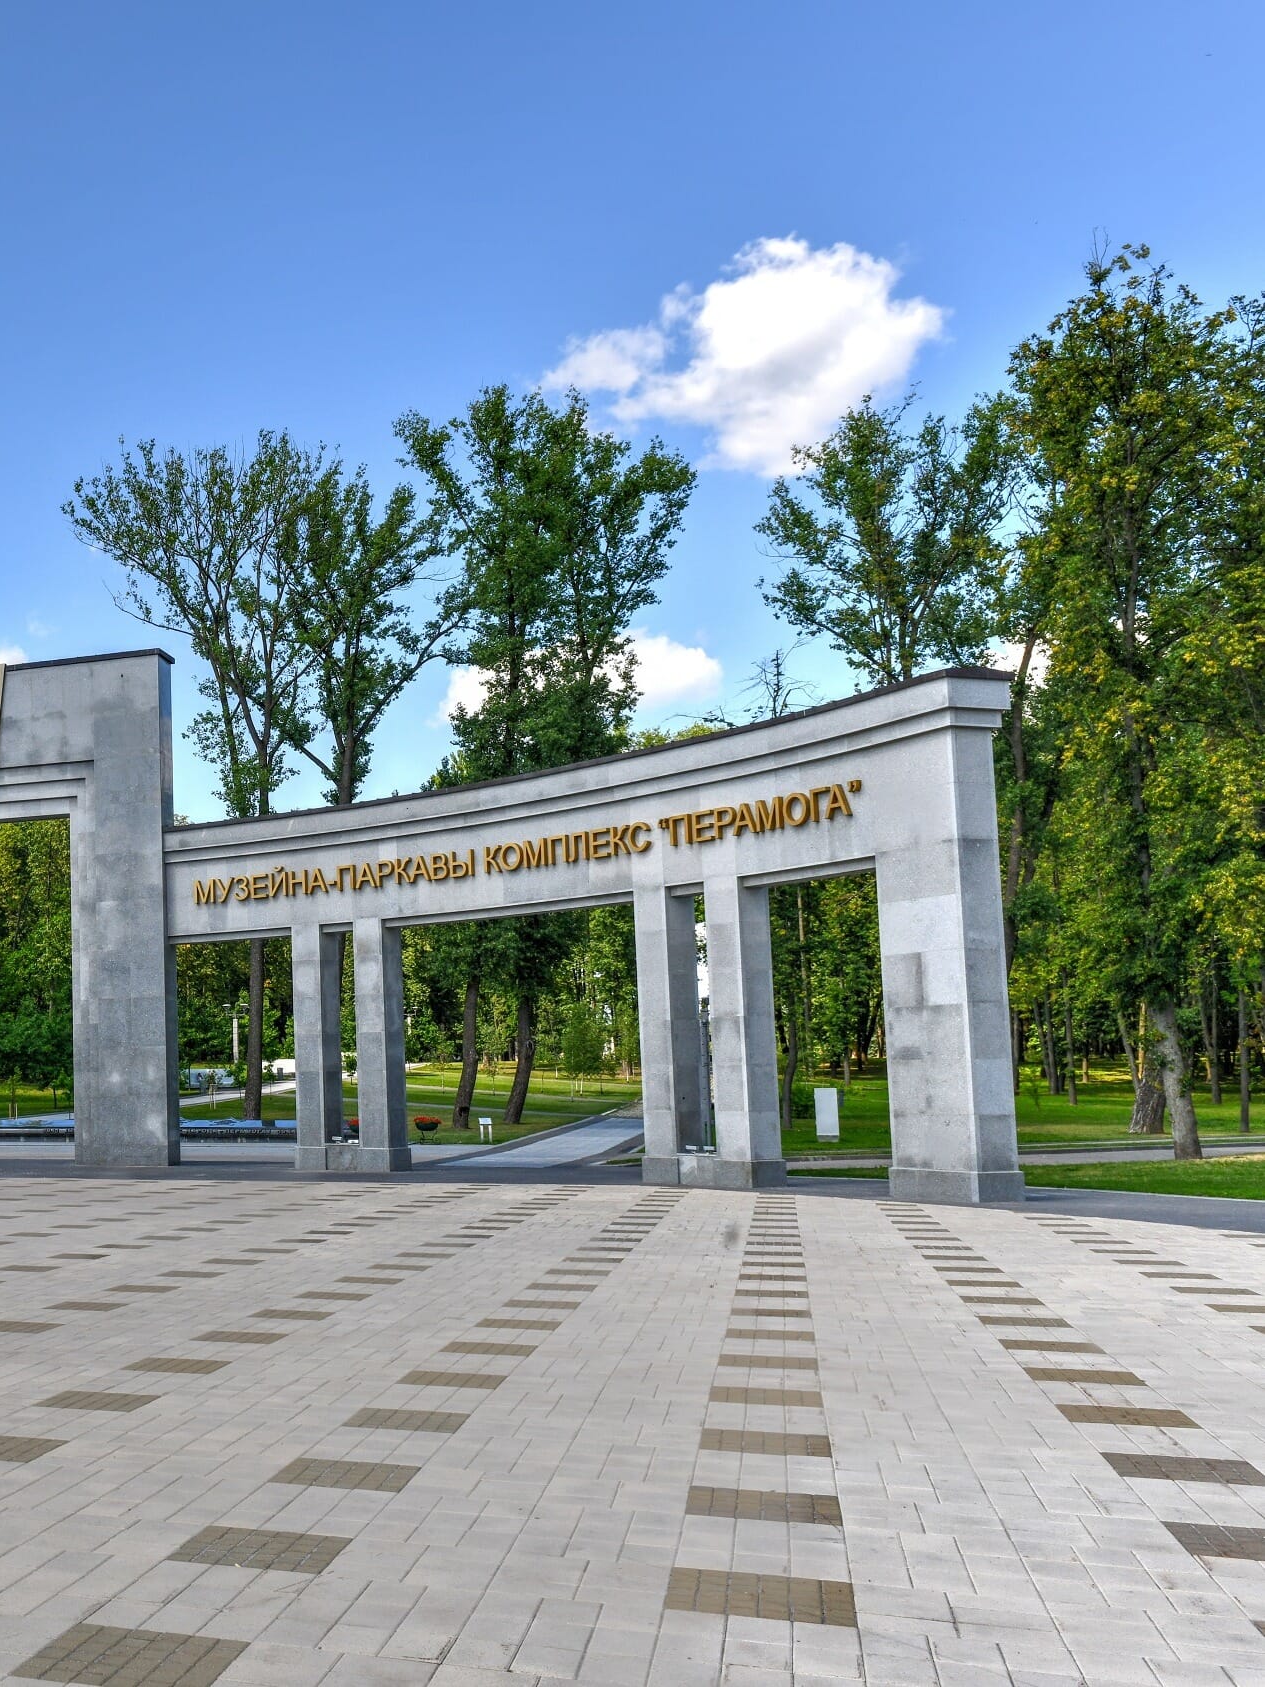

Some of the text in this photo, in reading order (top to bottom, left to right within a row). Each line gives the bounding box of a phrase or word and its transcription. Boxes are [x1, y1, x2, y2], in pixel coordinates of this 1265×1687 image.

[193, 779, 862, 904] МУЗЕЙНА-ПАРКАВЫ КОМПЛЕКС “ПЕРАМОГА”
